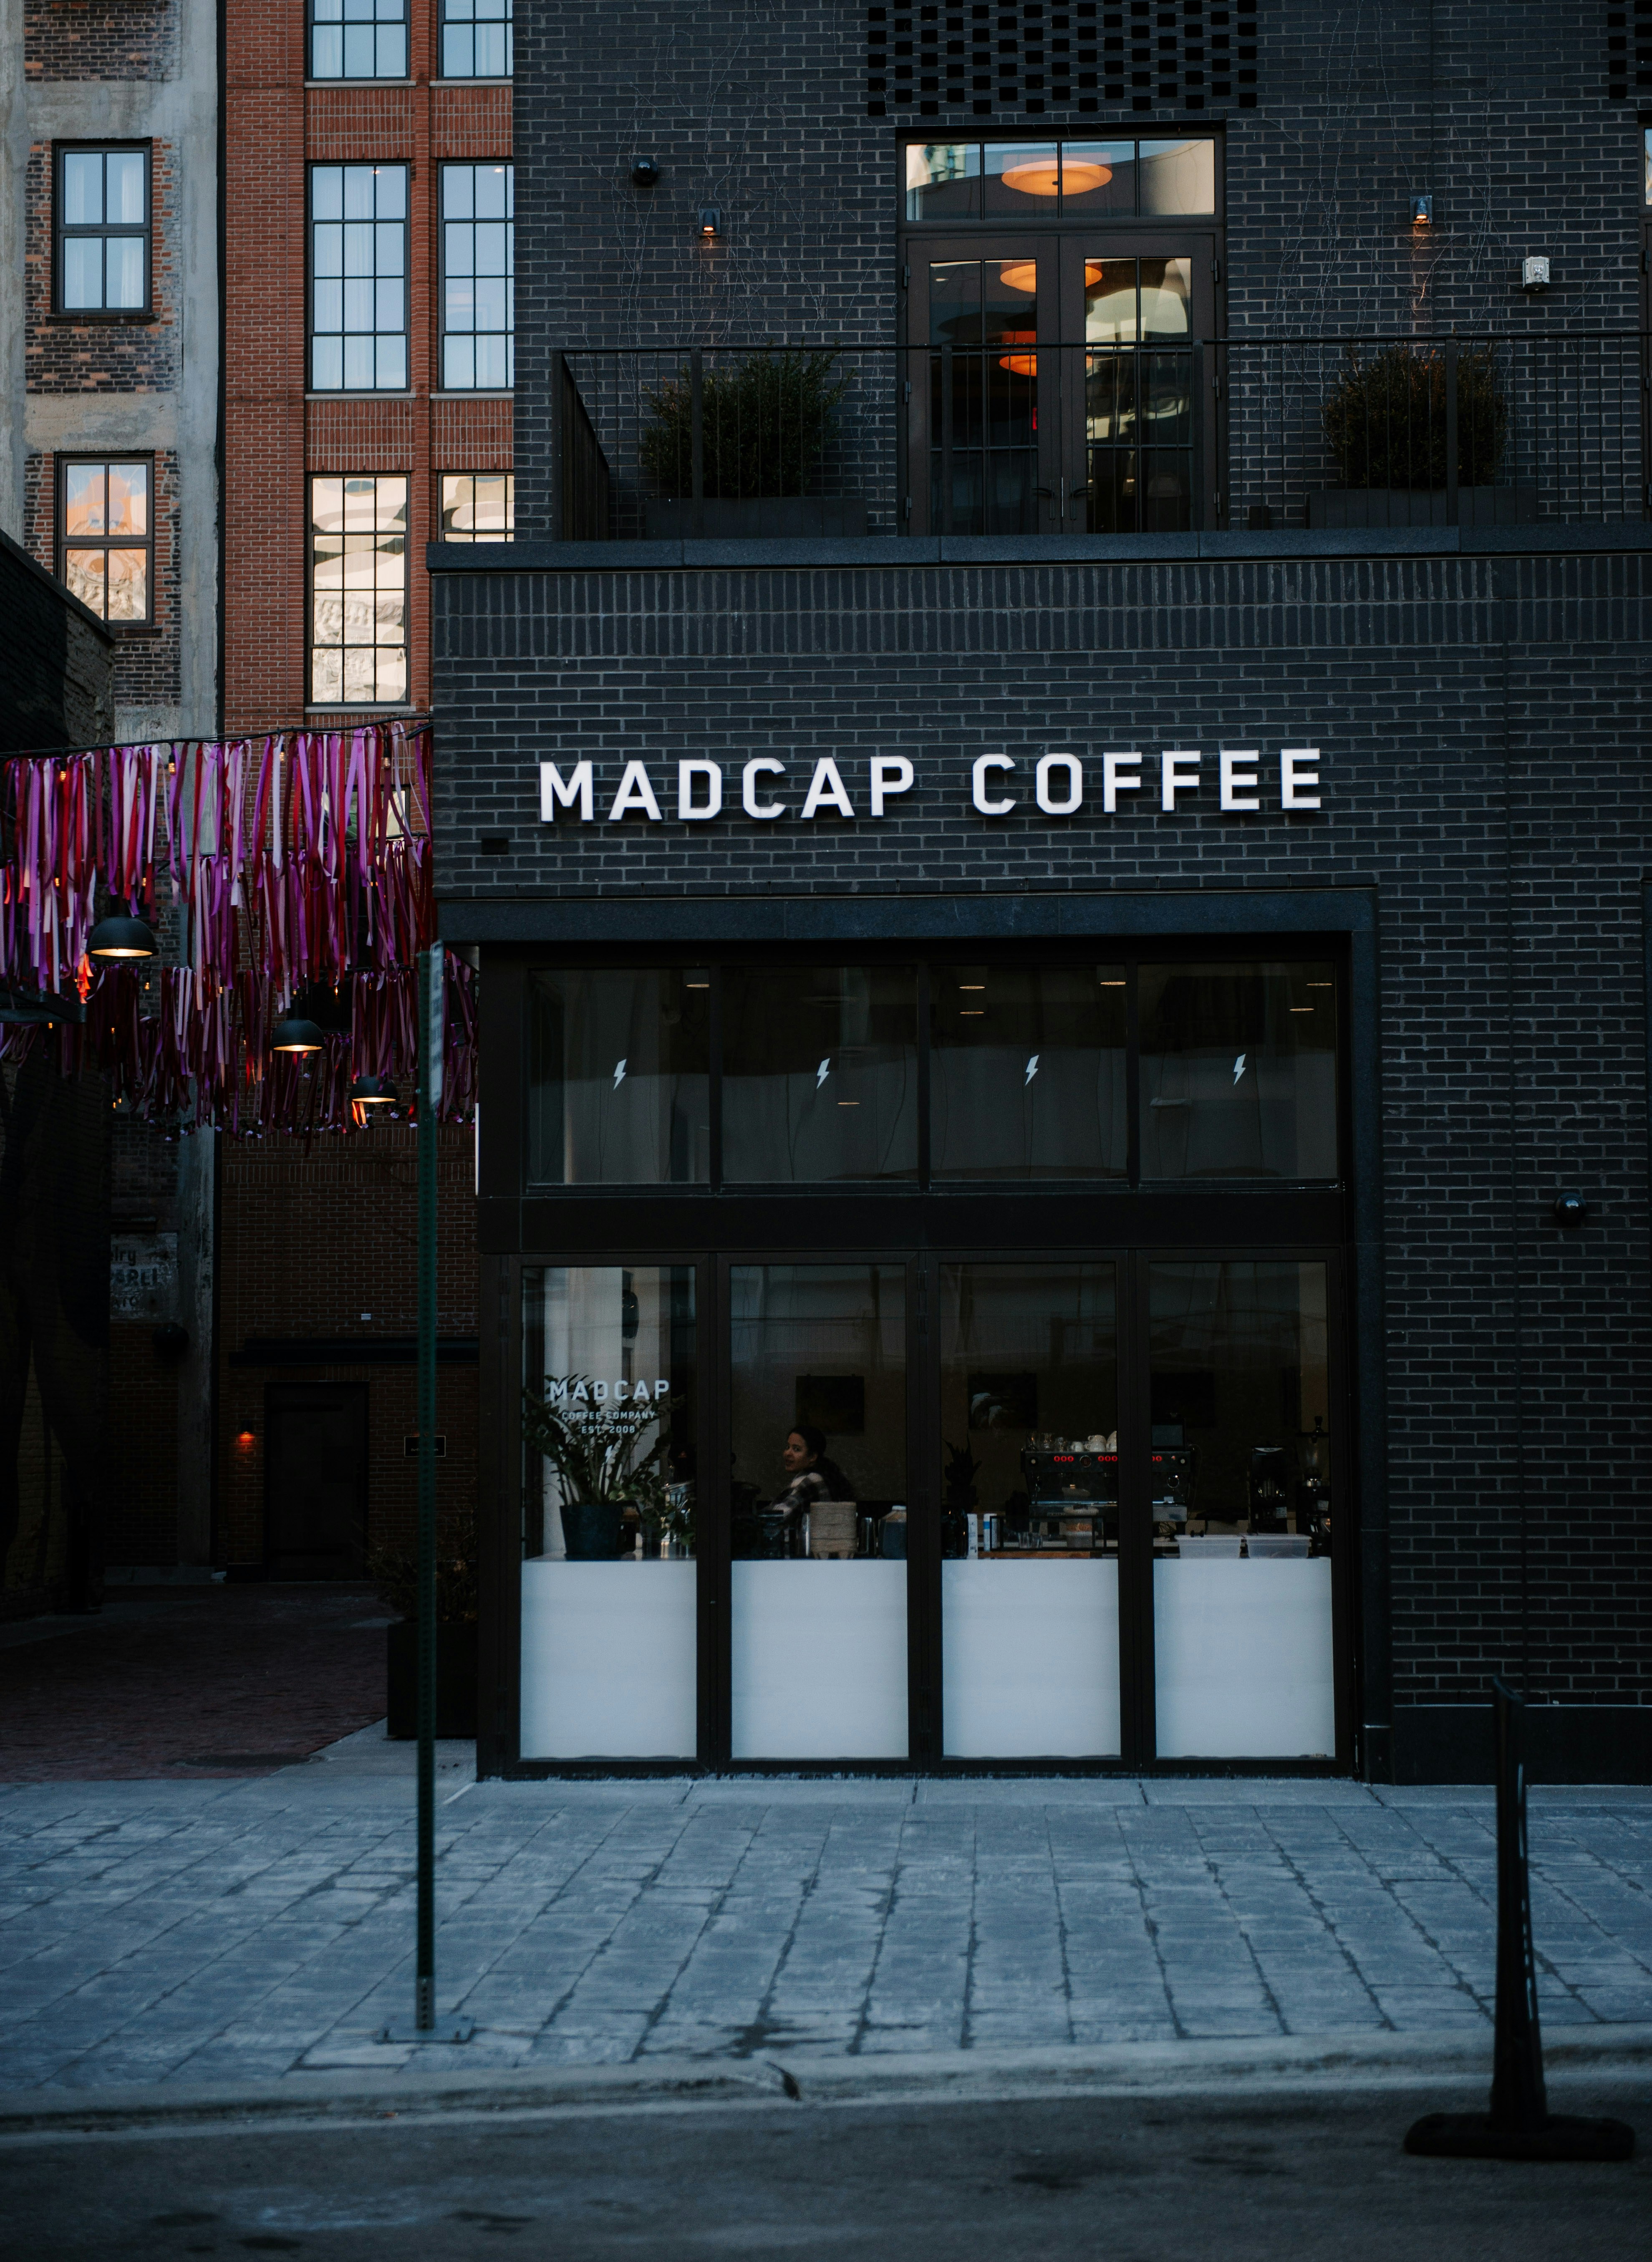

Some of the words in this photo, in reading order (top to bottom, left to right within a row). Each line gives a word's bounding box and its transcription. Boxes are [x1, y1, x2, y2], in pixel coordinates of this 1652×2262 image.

[540, 756, 914, 822] MADCAP
[972, 748, 1322, 815] COFFEE
[550, 1380, 670, 1401] MADCAP
[562, 1411, 601, 1419] COFFEE
[606, 1411, 656, 1419] COMPANY
[609, 1425, 636, 1434] 2008
